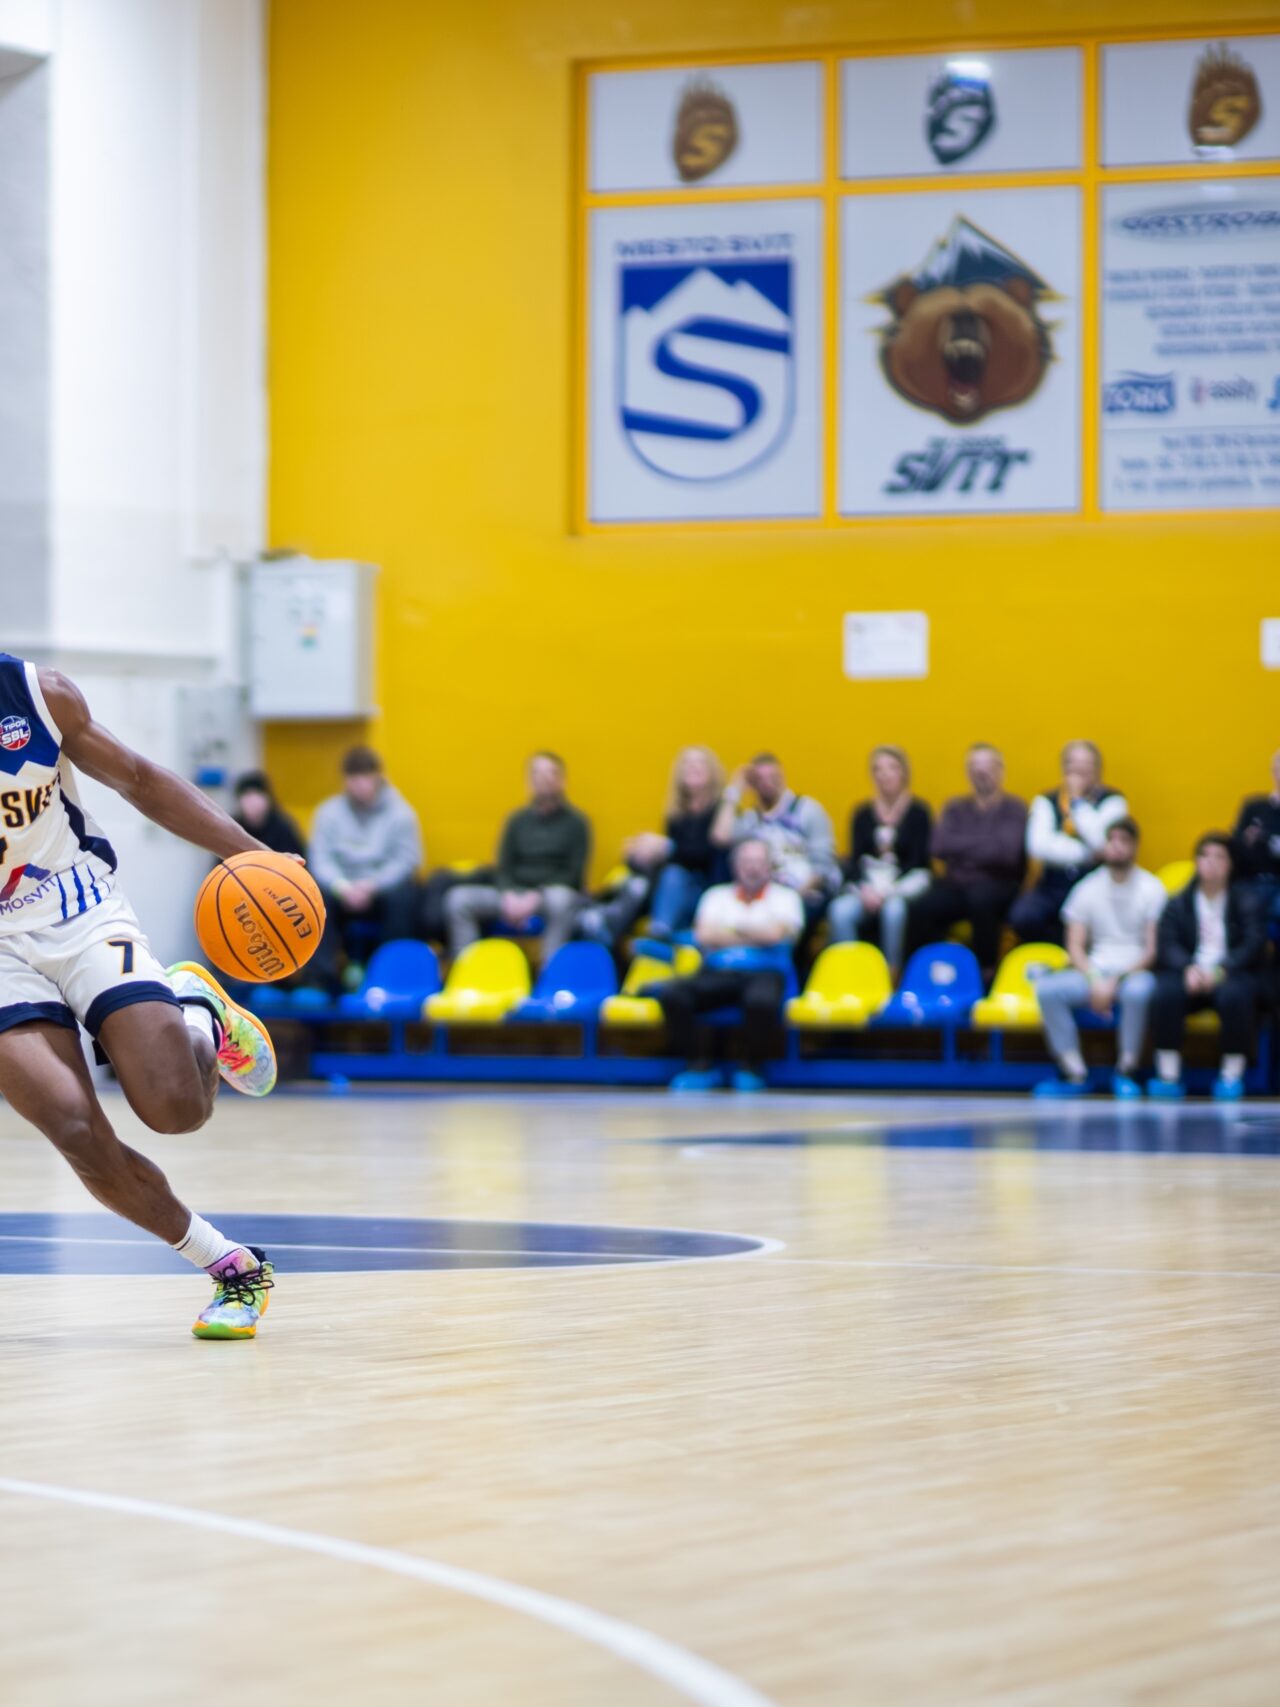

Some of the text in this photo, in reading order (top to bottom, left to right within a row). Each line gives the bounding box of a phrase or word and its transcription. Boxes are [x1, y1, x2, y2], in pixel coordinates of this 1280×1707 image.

[1, 728, 29, 746] SBL
[234, 902, 286, 977] Wilson
[107, 940, 135, 975] 7
